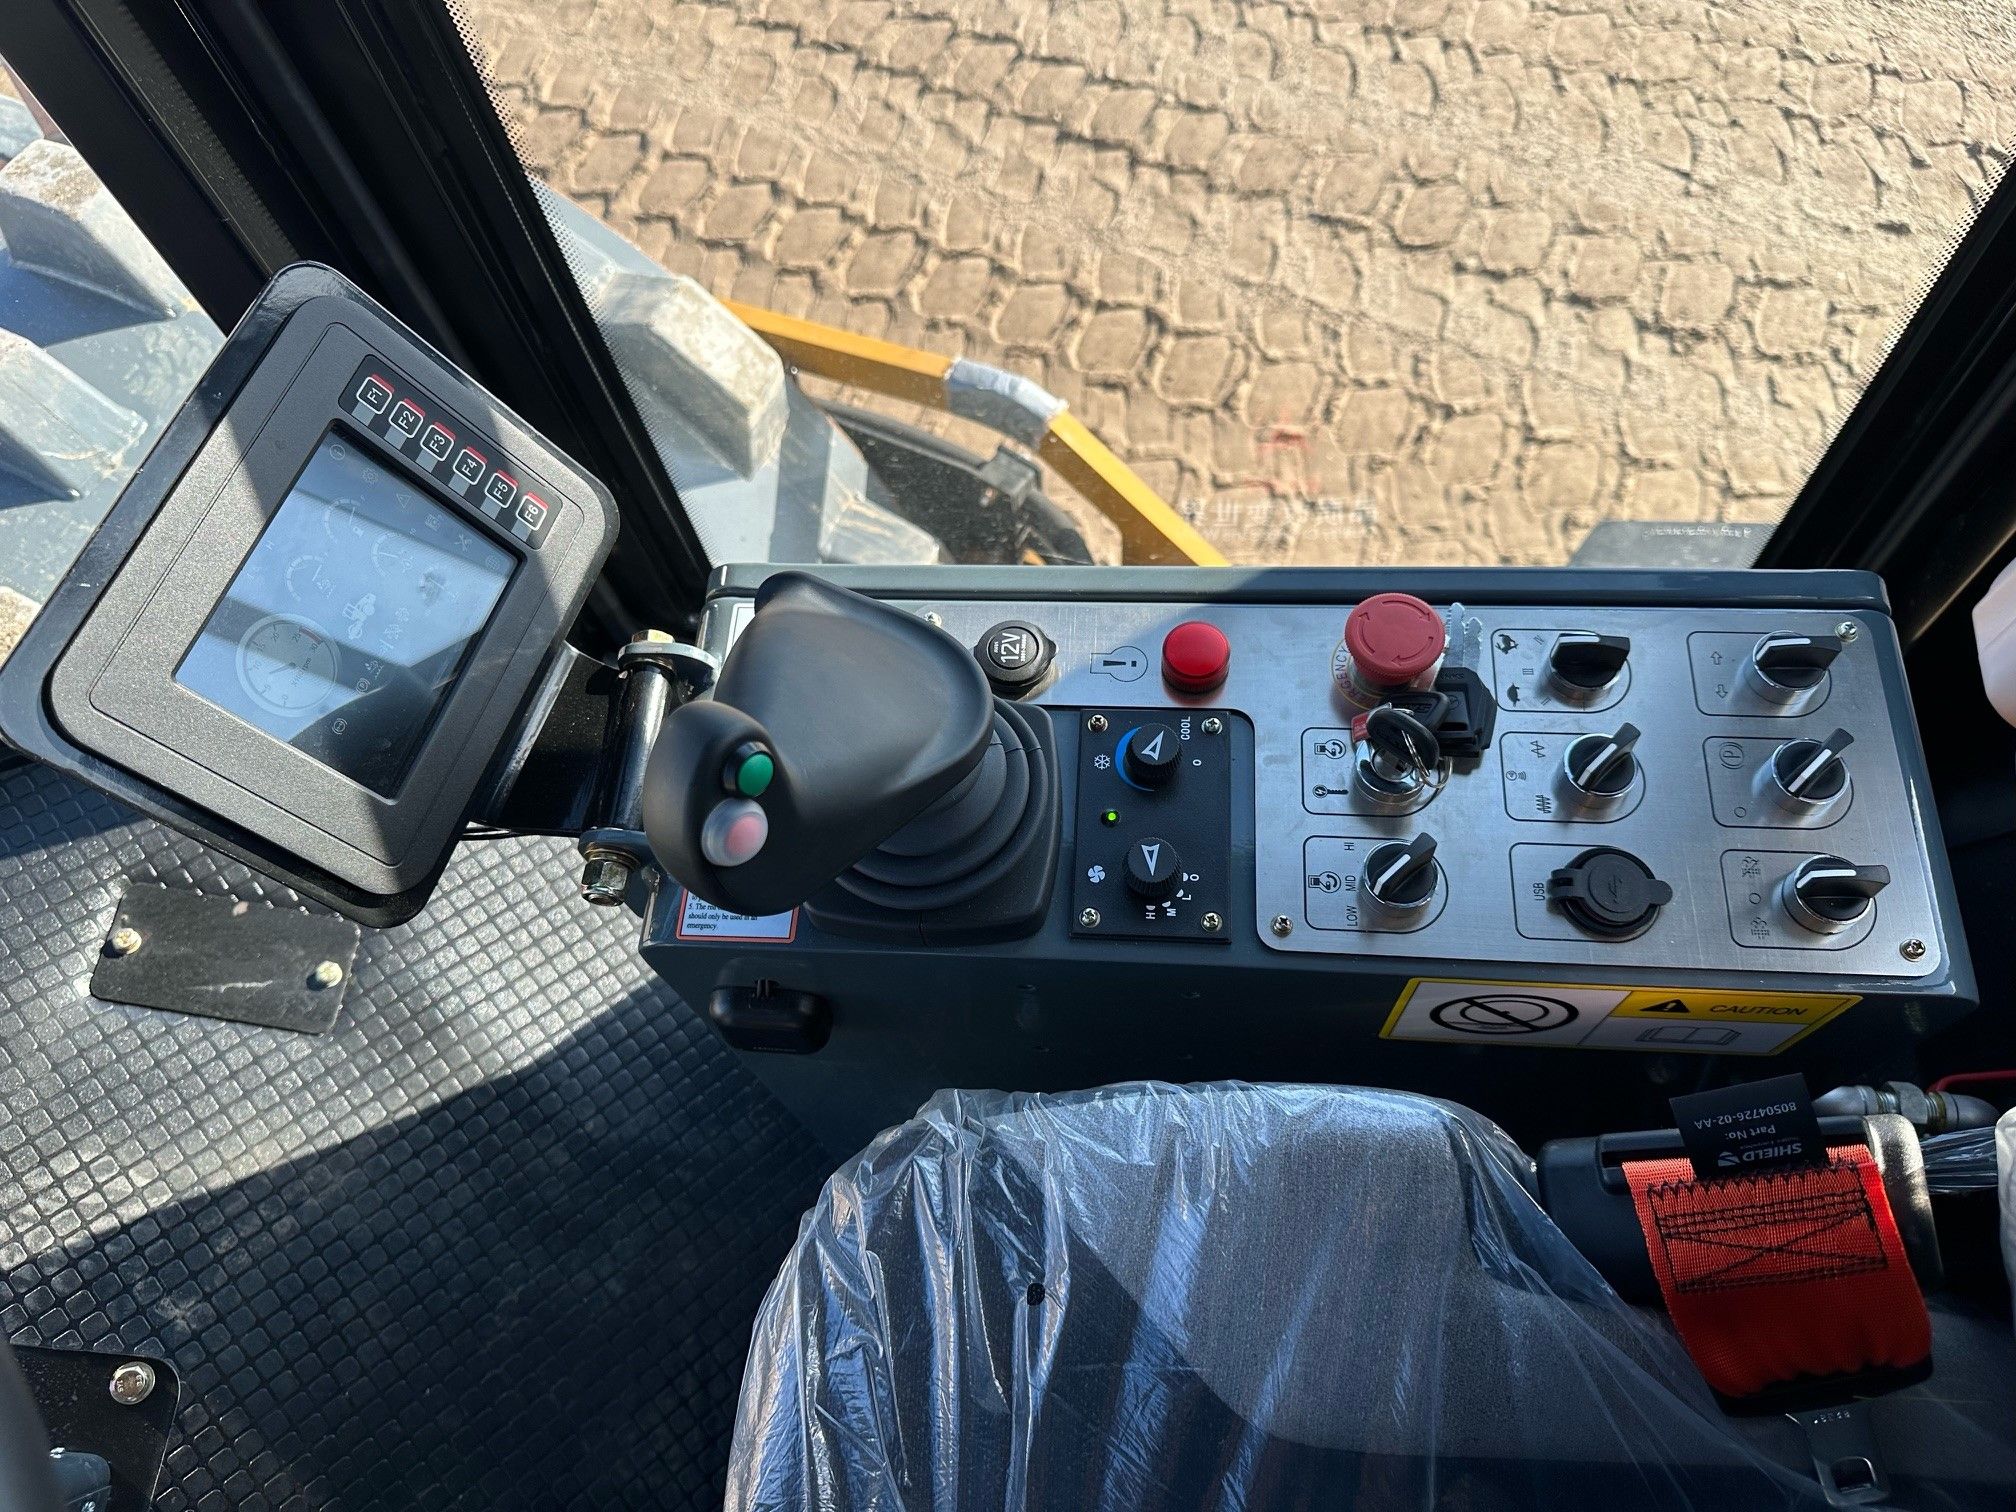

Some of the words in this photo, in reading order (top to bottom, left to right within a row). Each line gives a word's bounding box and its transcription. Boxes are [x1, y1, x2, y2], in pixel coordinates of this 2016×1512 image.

[366, 387, 383, 404] F1
[398, 410, 415, 429] F2
[429, 434, 445, 453] F3
[462, 458, 477, 477] F4
[493, 482, 508, 500] F5
[524, 505, 539, 523] F6
[1000, 632, 1021, 663] 12V
[1180, 716, 1191, 741] COOL
[1344, 842, 1354, 851] HI
[1345, 875, 1356, 892] MID
[1532, 882, 1545, 901] USB
[708, 913, 721, 921] only
[1145, 912, 1156, 920] H
[1166, 908, 1177, 917] M
[1346, 905, 1358, 927] LOW
[1709, 1004, 1809, 1016] CAUTION
[1694, 1101, 1798, 1130] 80504726-02-AA
[1749, 1124, 1777, 1137] Part
[1742, 1142, 1803, 1161] SHIELD
